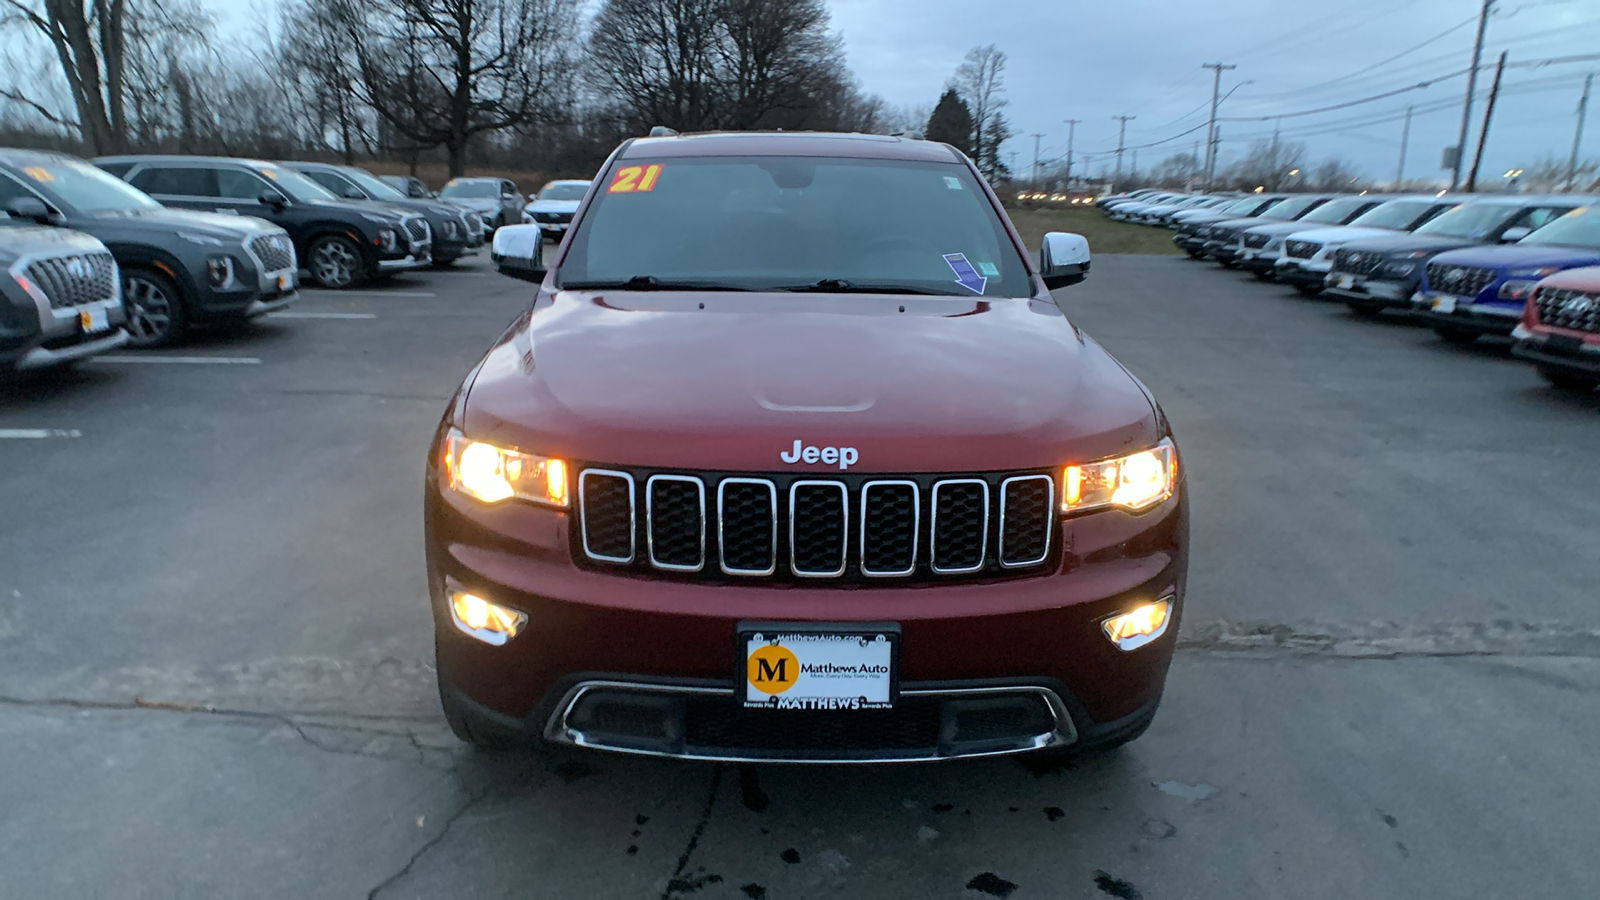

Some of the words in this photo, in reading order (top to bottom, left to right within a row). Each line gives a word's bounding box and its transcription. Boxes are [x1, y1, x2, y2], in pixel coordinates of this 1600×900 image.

[610, 165, 659, 192] 21
[780, 439, 859, 470] Jeep
[776, 633, 863, 642] MatthewsAuto.com
[754, 657, 789, 683] M
[800, 662, 858, 674] Matthews
[858, 663, 889, 674] Auto
[777, 697, 860, 710] MATTHEWS
